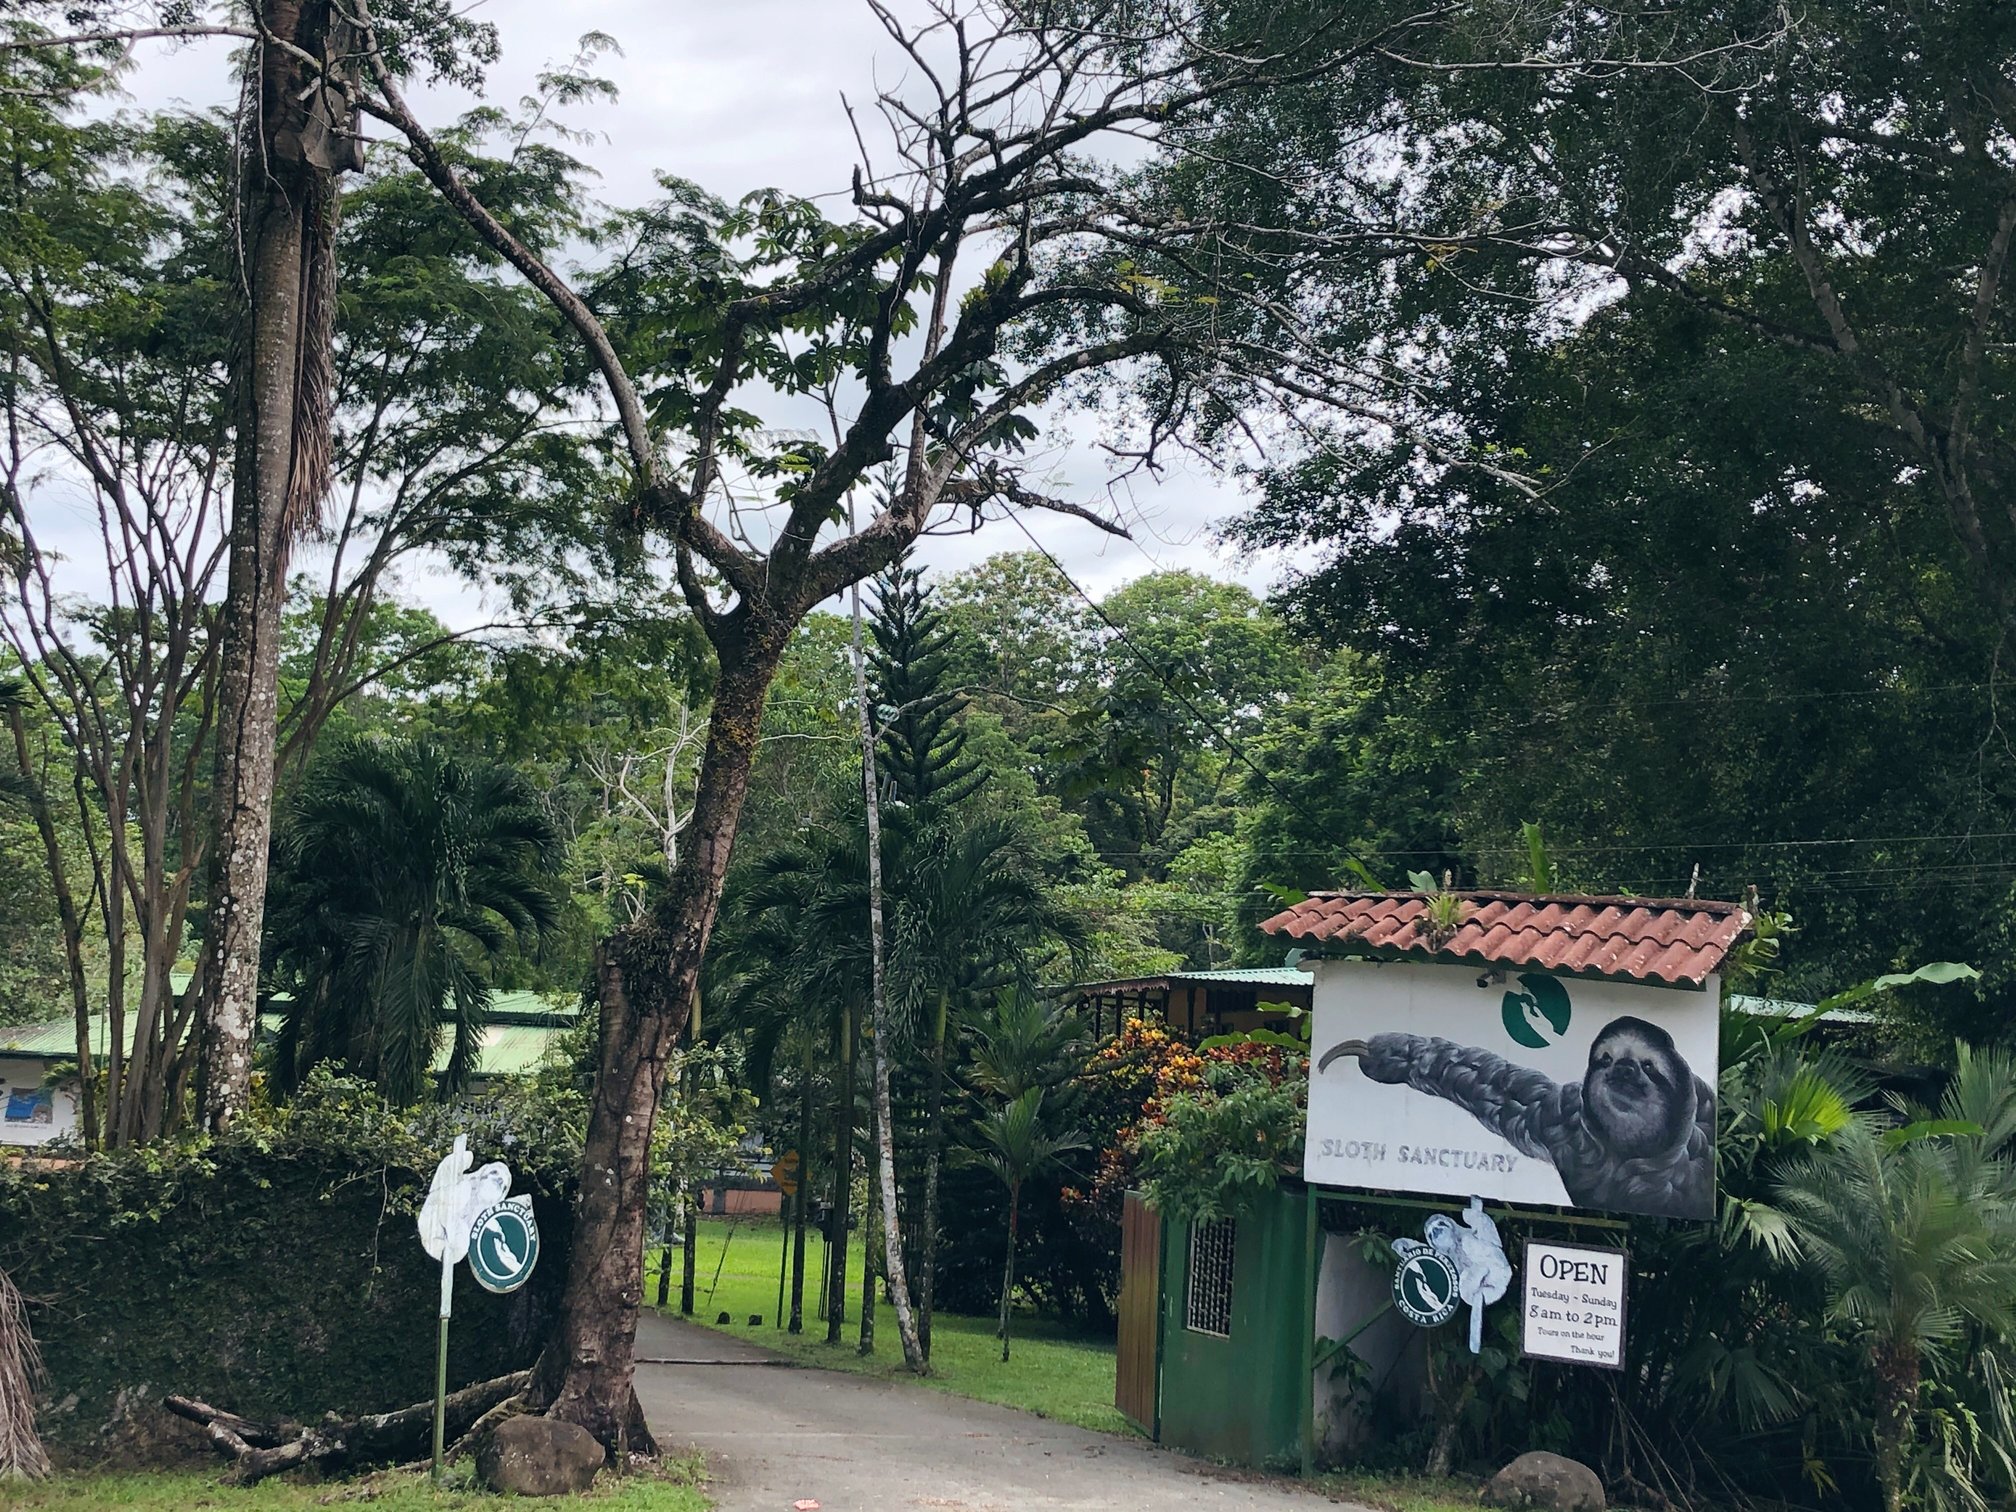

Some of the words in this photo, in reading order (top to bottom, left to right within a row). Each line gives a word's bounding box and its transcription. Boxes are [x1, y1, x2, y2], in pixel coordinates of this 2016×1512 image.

[1320, 1139, 1387, 1162] SLOTH
[1397, 1145, 1518, 1173] SANCTUARY
[471, 1206, 494, 1240] SLOTH
[494, 1202, 536, 1242] SANCTUARY
[1540, 1254, 1608, 1285] OPEN
[1531, 1287, 1570, 1304] Tuesday
[1581, 1294, 1617, 1310] Sunday
[1398, 1300, 1427, 1324] COSTA
[1432, 1304, 1454, 1323] RICA
[1566, 1311, 1580, 1323] to
[1538, 1326, 1559, 1337] Tours
[1560, 1329, 1571, 1338] on
[1572, 1330, 1585, 1339] the
[1586, 1331, 1605, 1341] hour
[1570, 1345, 1594, 1356] Thank
[1597, 1349, 1615, 1359] you!
